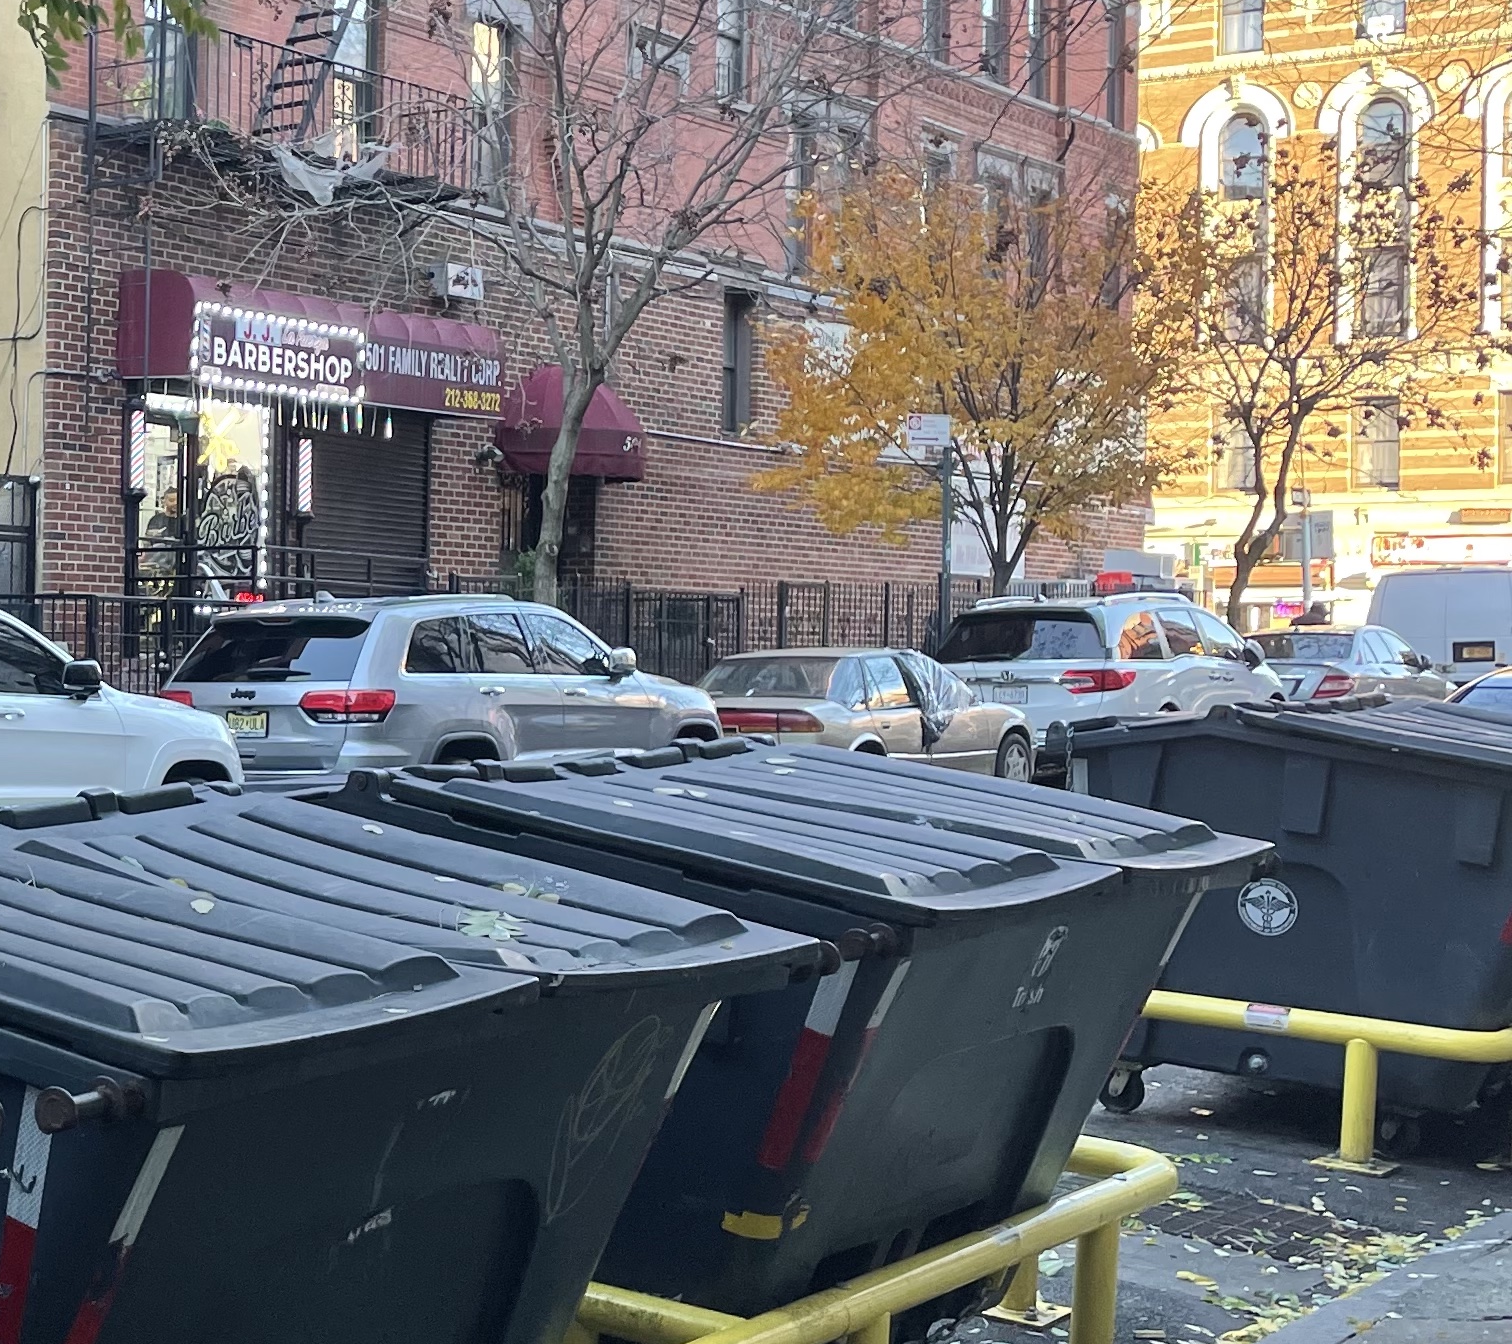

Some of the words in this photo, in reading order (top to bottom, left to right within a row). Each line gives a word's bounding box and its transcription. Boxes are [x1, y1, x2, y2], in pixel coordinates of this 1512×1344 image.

[213, 337, 353, 385] BARBERSHOP
[365, 343, 385, 372] 501
[388, 345, 428, 377] FAMILY
[471, 356, 502, 387] CORP.
[230, 688, 256, 700] Jeep
